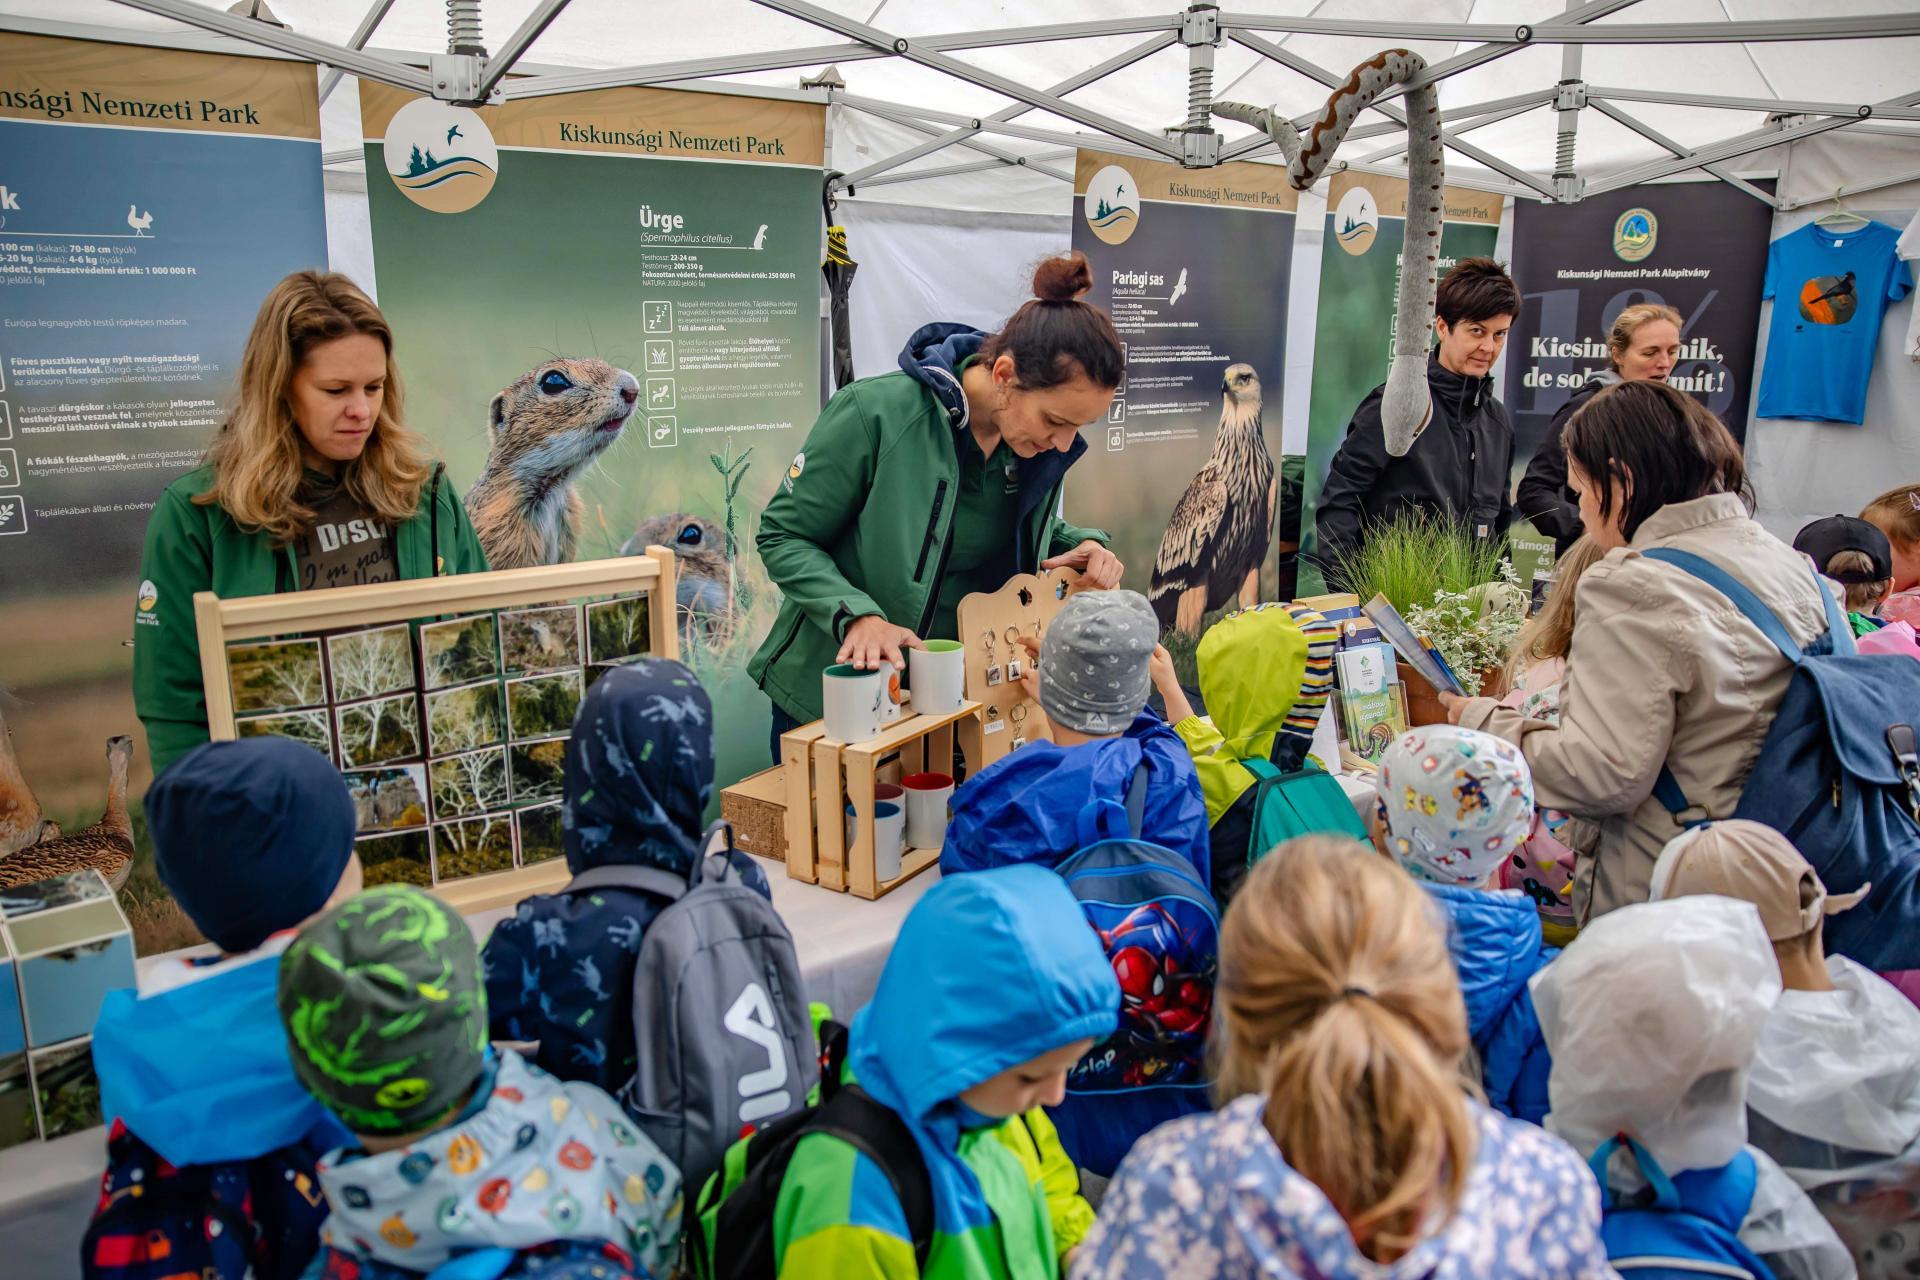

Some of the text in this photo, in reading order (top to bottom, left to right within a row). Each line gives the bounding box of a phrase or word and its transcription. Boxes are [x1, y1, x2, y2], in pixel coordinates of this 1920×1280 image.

[0, 88, 260, 124] nsági Nemzeti Park
[560, 122, 785, 156] Kiskunsági Nemzeti Park
[1169, 182, 1281, 206] Kiskunsági Nemzeti Park
[640, 204, 684, 233] Ürge
[1472, 207, 1489, 219] Park
[640, 232, 733, 244] (Spermophilus citellus)
[21, 254, 33, 264] kg
[86, 256, 97, 265] kg
[1438, 255, 1456, 268] erics
[33, 266, 115, 274] természetvédelmi
[118, 266, 144, 275] érték:
[1557, 268, 1711, 280] Kiskunsági Nemzeti Park Alapítvány
[1112, 270, 1164, 288] Parlagi sas
[38, 319, 91, 329] legnagyobb
[1531, 337, 1724, 364] Kicsin nik,
[11, 354, 200, 367] Füves pusztákon vagy nyílt mezőgazdasági
[12, 368, 67, 376] területeken
[68, 366, 103, 375] fészkel.
[1523, 367, 1552, 388] de
[1668, 371, 1726, 393] mít!
[59, 403, 104, 413] dürgéskor
[170, 399, 215, 410] jellegzetes
[20, 414, 80, 425] testhelyzetet
[21, 424, 65, 434] messziről
[67, 423, 110, 432] láthatóvá
[111, 421, 140, 429] válnak
[149, 419, 178, 429] tyúkok
[180, 418, 217, 426] számára.
[66, 453, 129, 464] fészekhagyók,
[161, 458, 200, 469] fészekalja
[35, 508, 91, 518] Táplálékában
[1538, 555, 1550, 566] és
